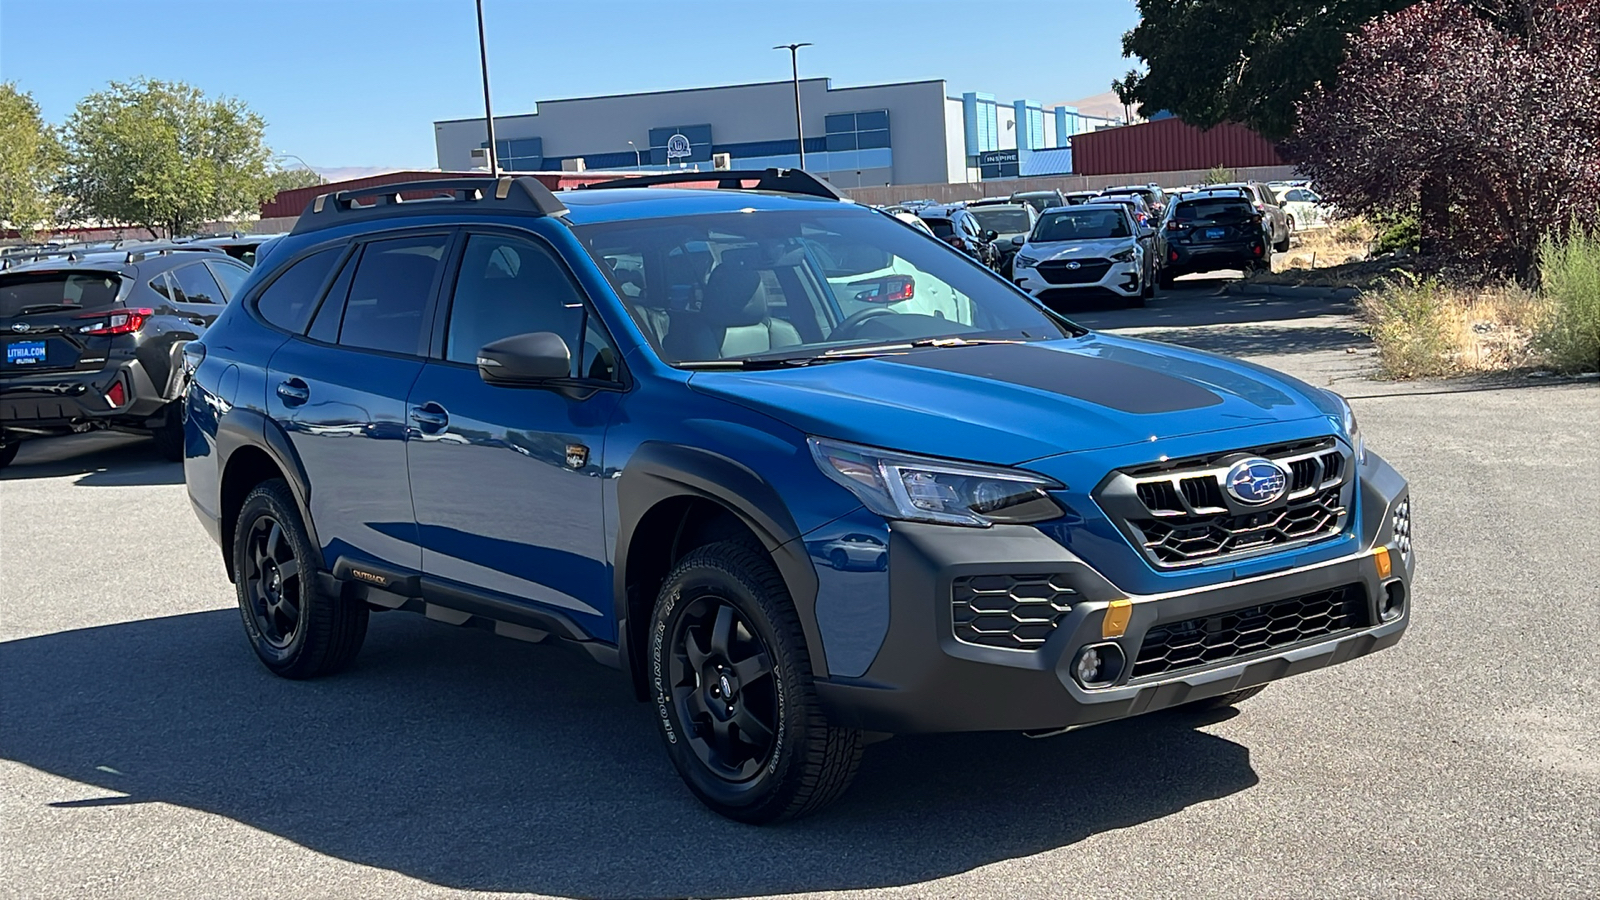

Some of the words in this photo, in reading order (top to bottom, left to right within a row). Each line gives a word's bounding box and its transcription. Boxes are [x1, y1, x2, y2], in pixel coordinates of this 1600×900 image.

[986, 154, 1016, 162] INSPIRE
[7, 347, 45, 357] LITHIA.COM
[353, 570, 386, 584] OUTBACK
[665, 587, 681, 617] A/T
[653, 620, 678, 744] GEOLANDAR
